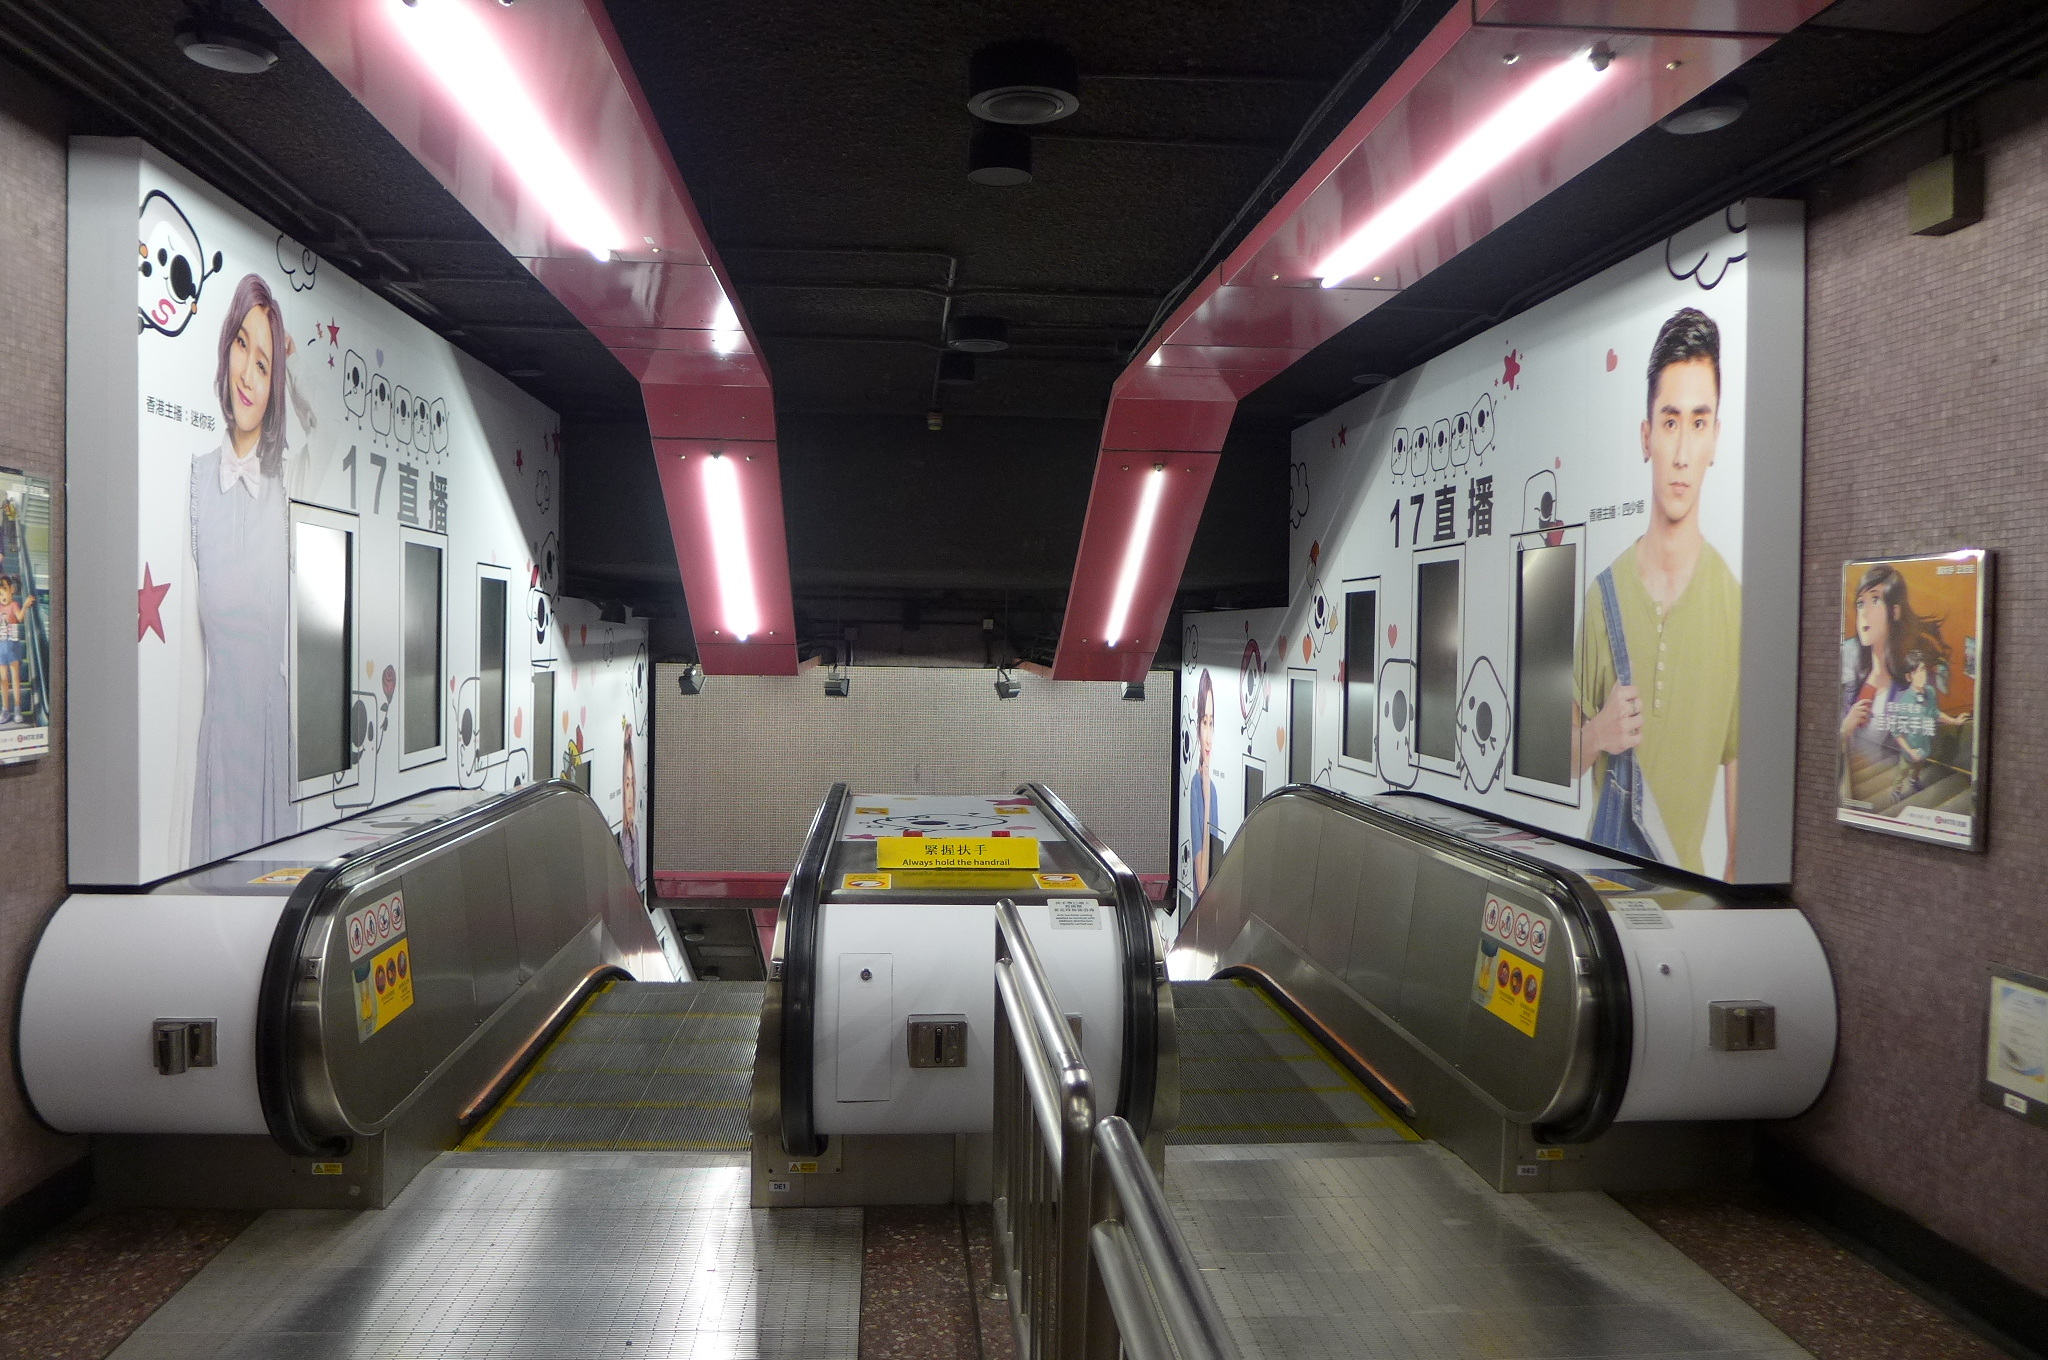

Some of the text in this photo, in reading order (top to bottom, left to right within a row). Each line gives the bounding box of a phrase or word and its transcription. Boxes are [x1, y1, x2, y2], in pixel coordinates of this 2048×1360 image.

[924, 844, 988, 856] 緊握扶手
[935, 858, 955, 866] hold
[957, 858, 972, 866] the
[973, 858, 1010, 866] handrail
